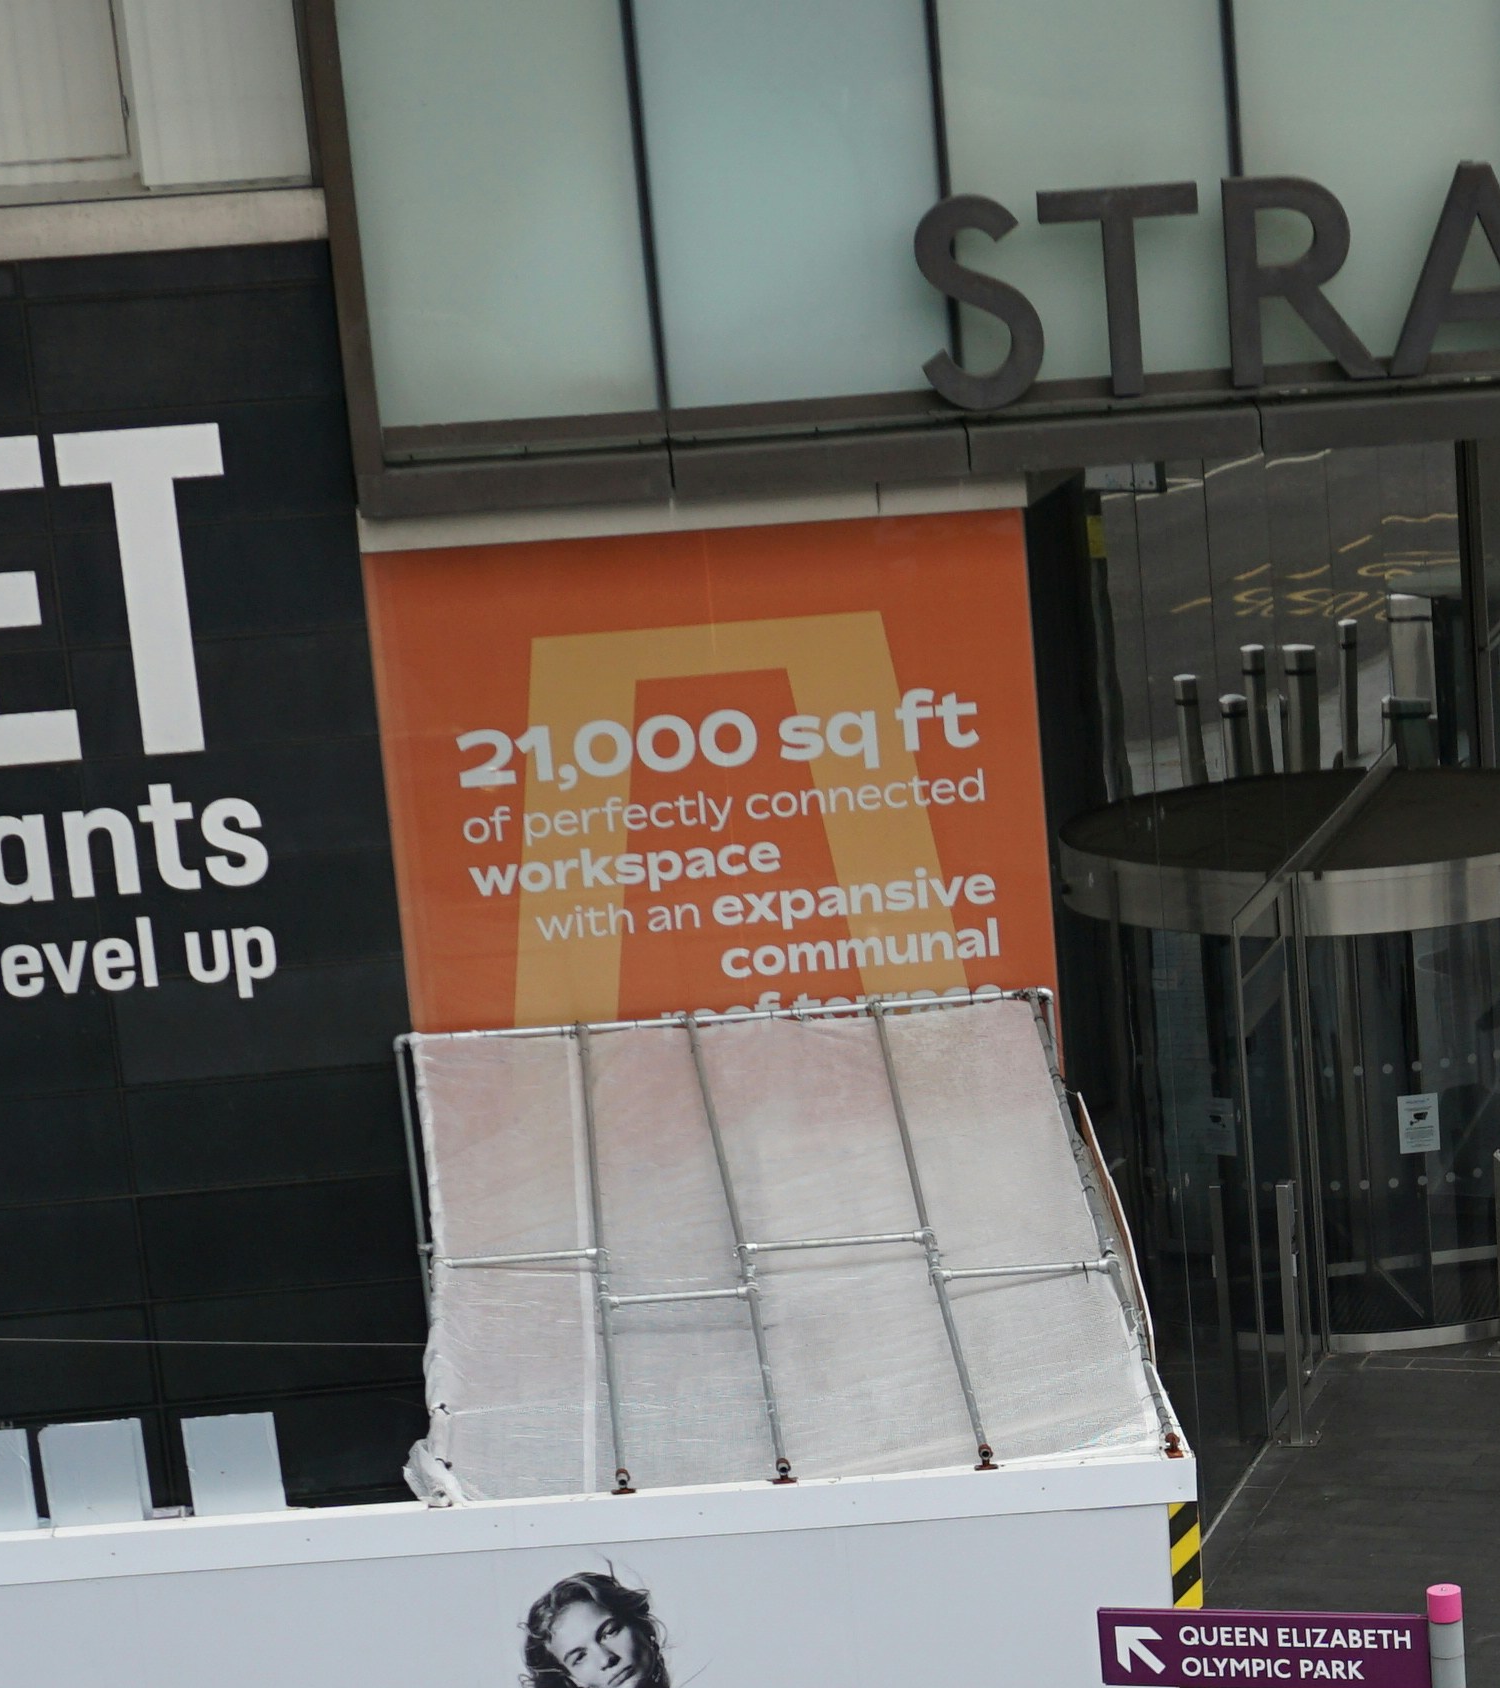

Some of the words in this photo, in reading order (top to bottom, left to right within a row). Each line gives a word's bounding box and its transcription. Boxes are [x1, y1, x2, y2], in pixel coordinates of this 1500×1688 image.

[456, 708, 758, 791] 21,000
[778, 708, 881, 769] sq
[895, 688, 980, 751] ft
[462, 806, 511, 844] of
[523, 791, 732, 846] perfectly
[745, 768, 986, 819] connected
[468, 841, 781, 897] workspace
[535, 903, 635, 941] with
[647, 900, 701, 933] an
[712, 867, 996, 929] expansive
[183, 922, 278, 999] up
[720, 917, 1001, 979] communal
[1178, 1625, 1269, 1648] QUEEN
[1277, 1627, 1412, 1650] ELIZABETH
[1181, 1656, 1292, 1679] OLYMPIC
[1299, 1659, 1365, 1681] PARK
